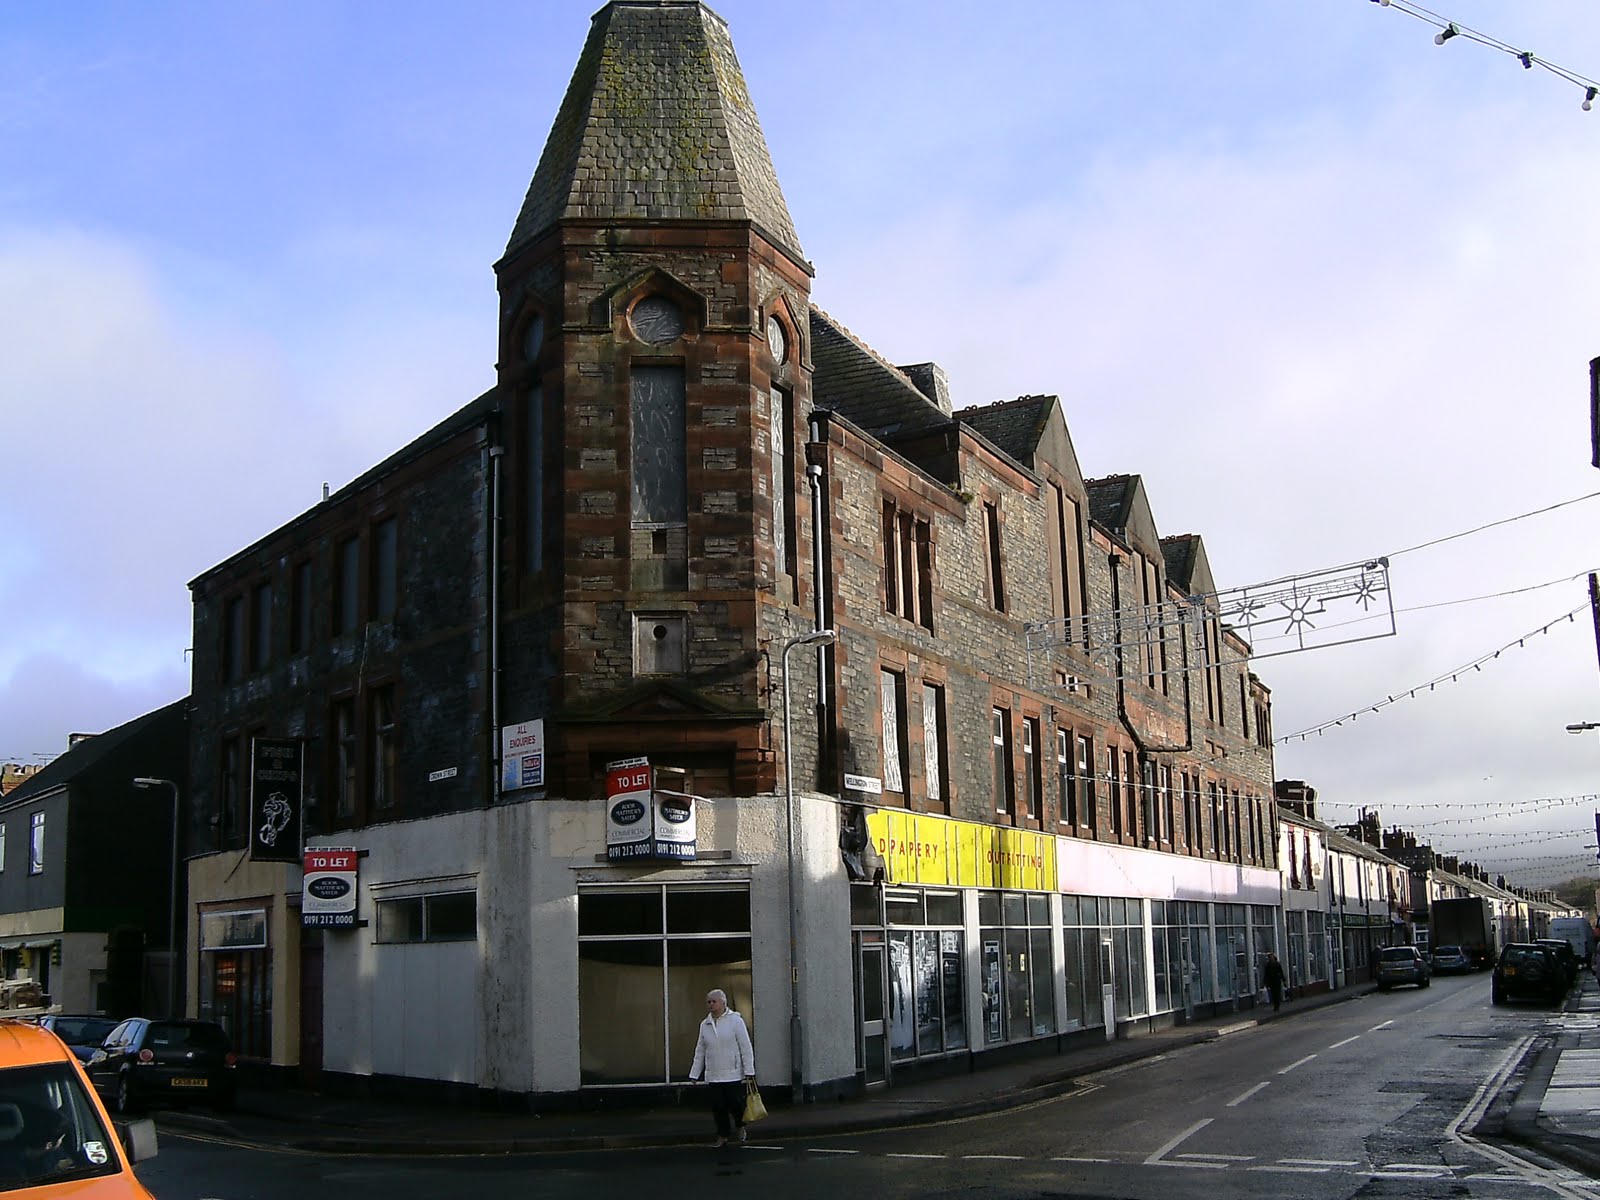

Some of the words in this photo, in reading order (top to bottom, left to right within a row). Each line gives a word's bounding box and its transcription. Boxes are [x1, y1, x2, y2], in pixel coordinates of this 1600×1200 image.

[517, 724, 528, 735] ALL
[509, 735, 537, 749] ENQUIRIES
[443, 768, 456, 778] STREET
[617, 777, 630, 788] TO
[632, 774, 648, 787] LET
[845, 776, 868, 788] WELLINGTON
[609, 846, 621, 858] 0191
[622, 845, 634, 857] 212
[635, 843, 651, 855] 0000
[656, 843, 669, 854] 0191
[669, 844, 681, 855] 212
[681, 845, 695, 856] 0000
[312, 858, 327, 867] TO
[330, 858, 349, 867] LET
[304, 915, 318, 924] 0191
[320, 915, 334, 924] 212
[335, 915, 354, 925] 0000
